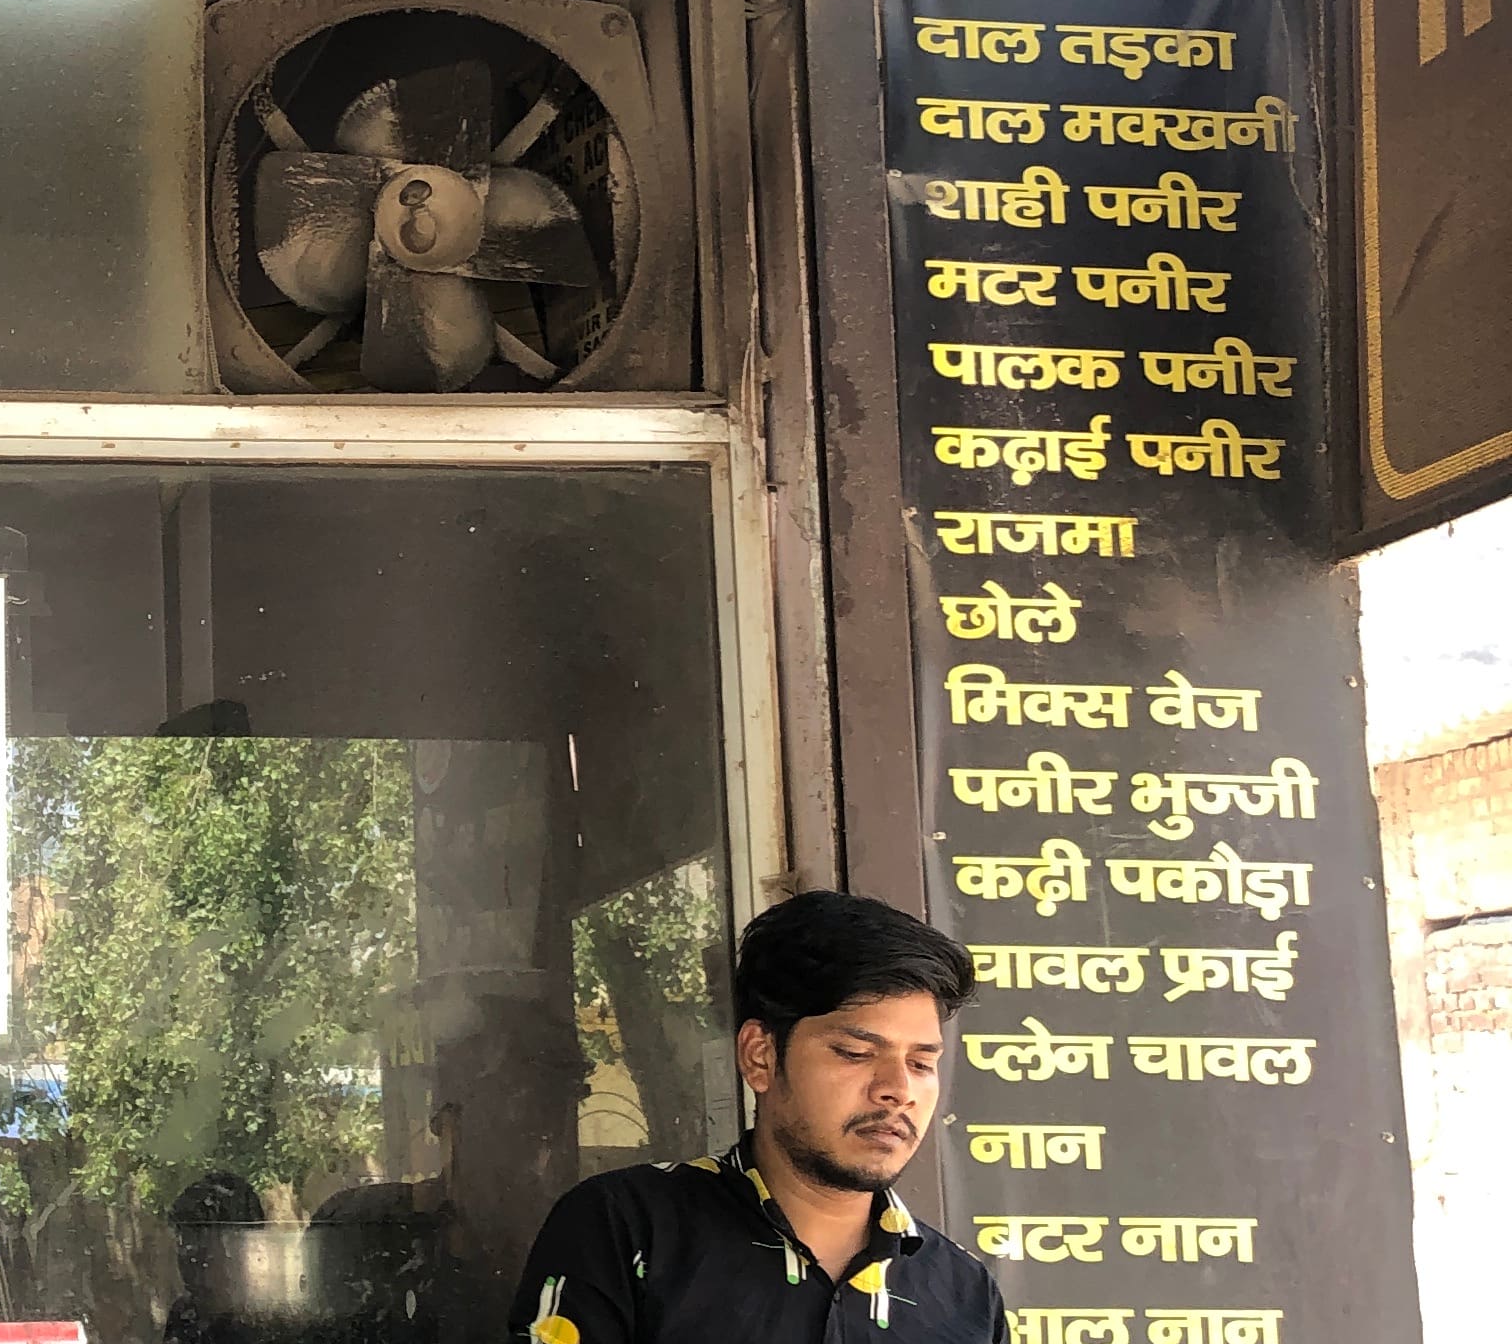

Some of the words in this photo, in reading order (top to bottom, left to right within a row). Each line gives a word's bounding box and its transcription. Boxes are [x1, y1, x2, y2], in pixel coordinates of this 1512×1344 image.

[914, 17, 1046, 63] दाल
[1055, 24, 1236, 80] तड़का
[916, 97, 1051, 144] दाल
[1060, 96, 1299, 152] मक्खनी
[924, 165, 1070, 227] शाही
[1084, 171, 1242, 232] पनीर
[925, 259, 1062, 306] मटर
[1072, 252, 1232, 312] पनीर
[928, 343, 1125, 390] पालक
[1139, 336, 1297, 397] पनीर
[931, 415, 1111, 485] कढ़ाई
[1125, 418, 1285, 479] पनीर
[934, 512, 1138, 558] राजमा
[939, 580, 1082, 642] छोले
[944, 663, 1132, 729] मिक्स
[1146, 670, 1262, 732] वेज
[948, 751, 1118, 815] पनीर
[1130, 757, 1319, 840] भुज्जी
[952, 838, 1091, 917] कढ़ी
[1105, 841, 1313, 921] पकौड़ा
[1160, 931, 1298, 1002] फ्राई
[962, 1016, 1113, 1081] प्लेन
[1128, 1036, 1317, 1085] चावल
[967, 1124, 1106, 1170] नान
[973, 1215, 1109, 1263] बटर
[1119, 1217, 1258, 1263] नान
